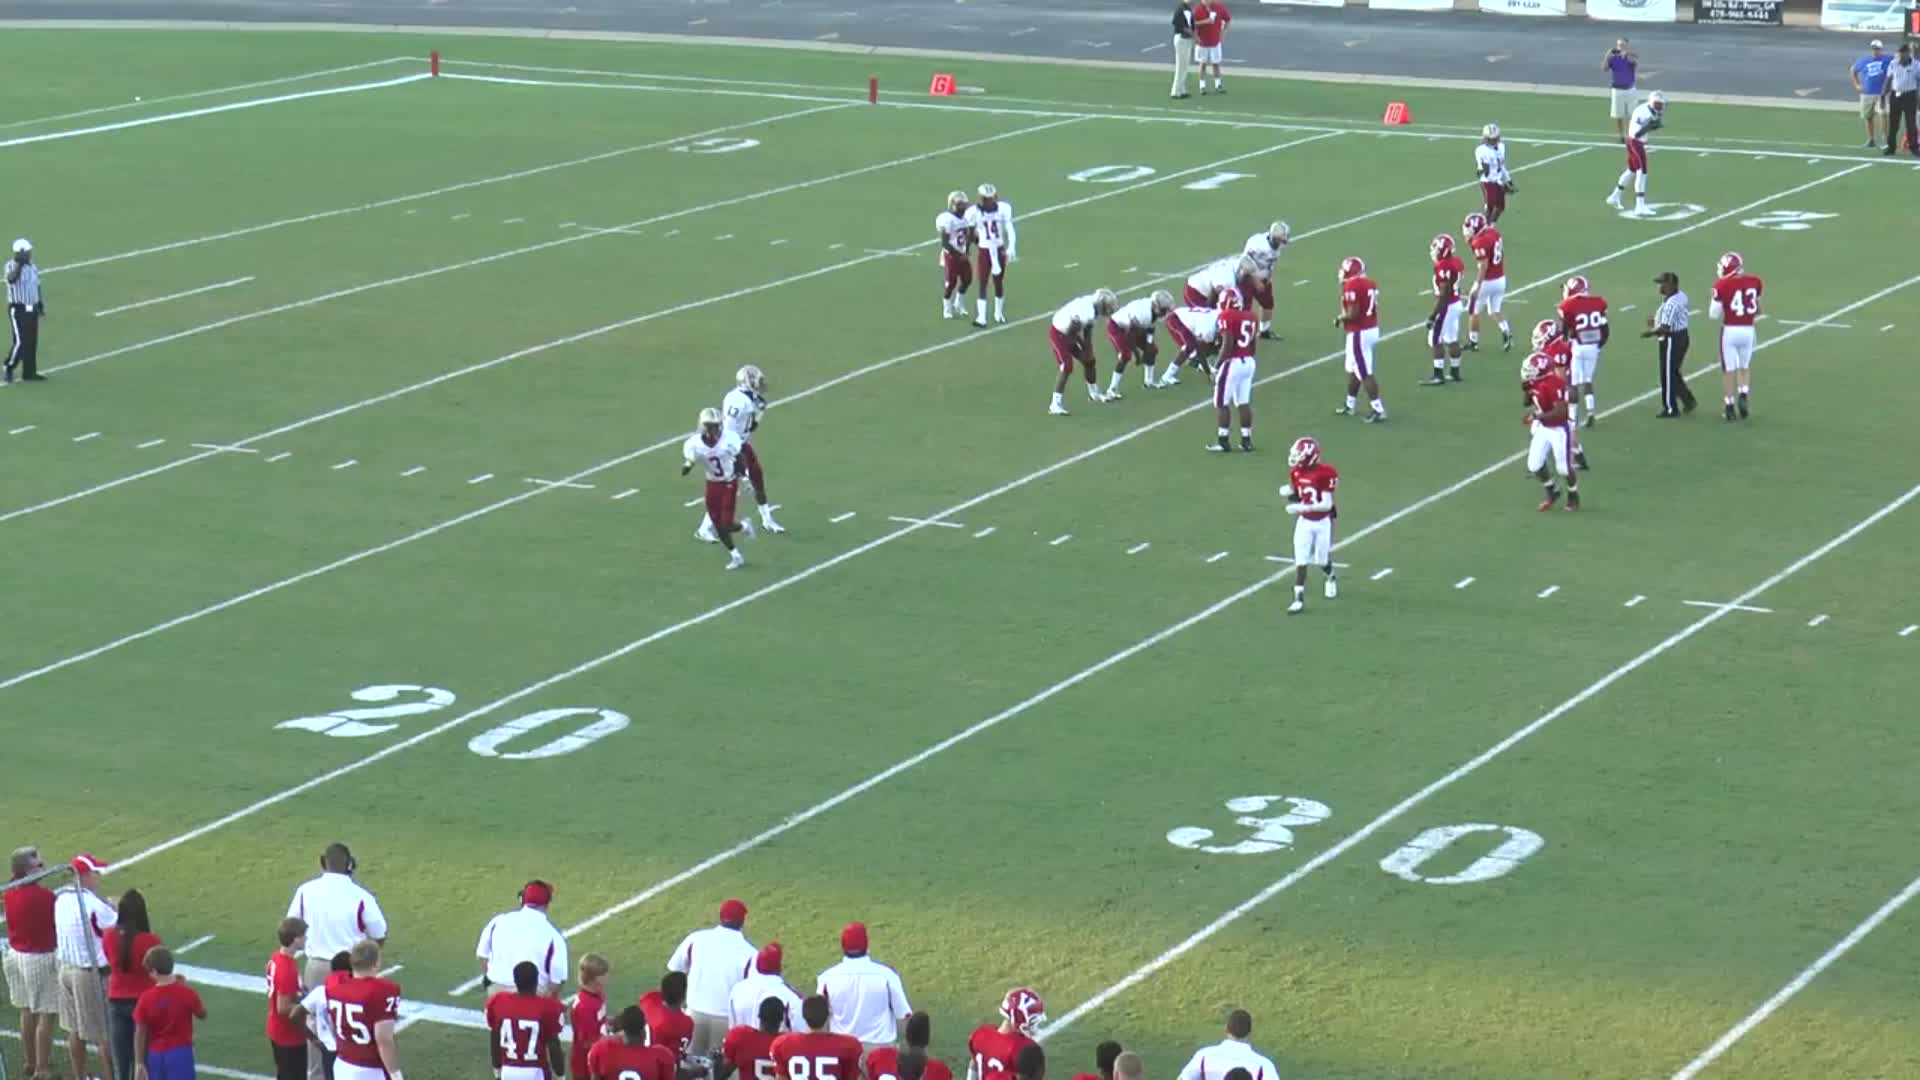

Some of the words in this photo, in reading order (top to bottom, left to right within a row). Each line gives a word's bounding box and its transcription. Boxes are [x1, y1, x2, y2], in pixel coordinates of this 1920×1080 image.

[982, 219, 1000, 241] 14
[1729, 287, 1759, 317] 43
[1237, 320, 1257, 348] 51
[1574, 310, 1603, 332] 20
[708, 455, 725, 478] 3
[328, 999, 372, 1046] 75
[500, 1018, 541, 1061] 47
